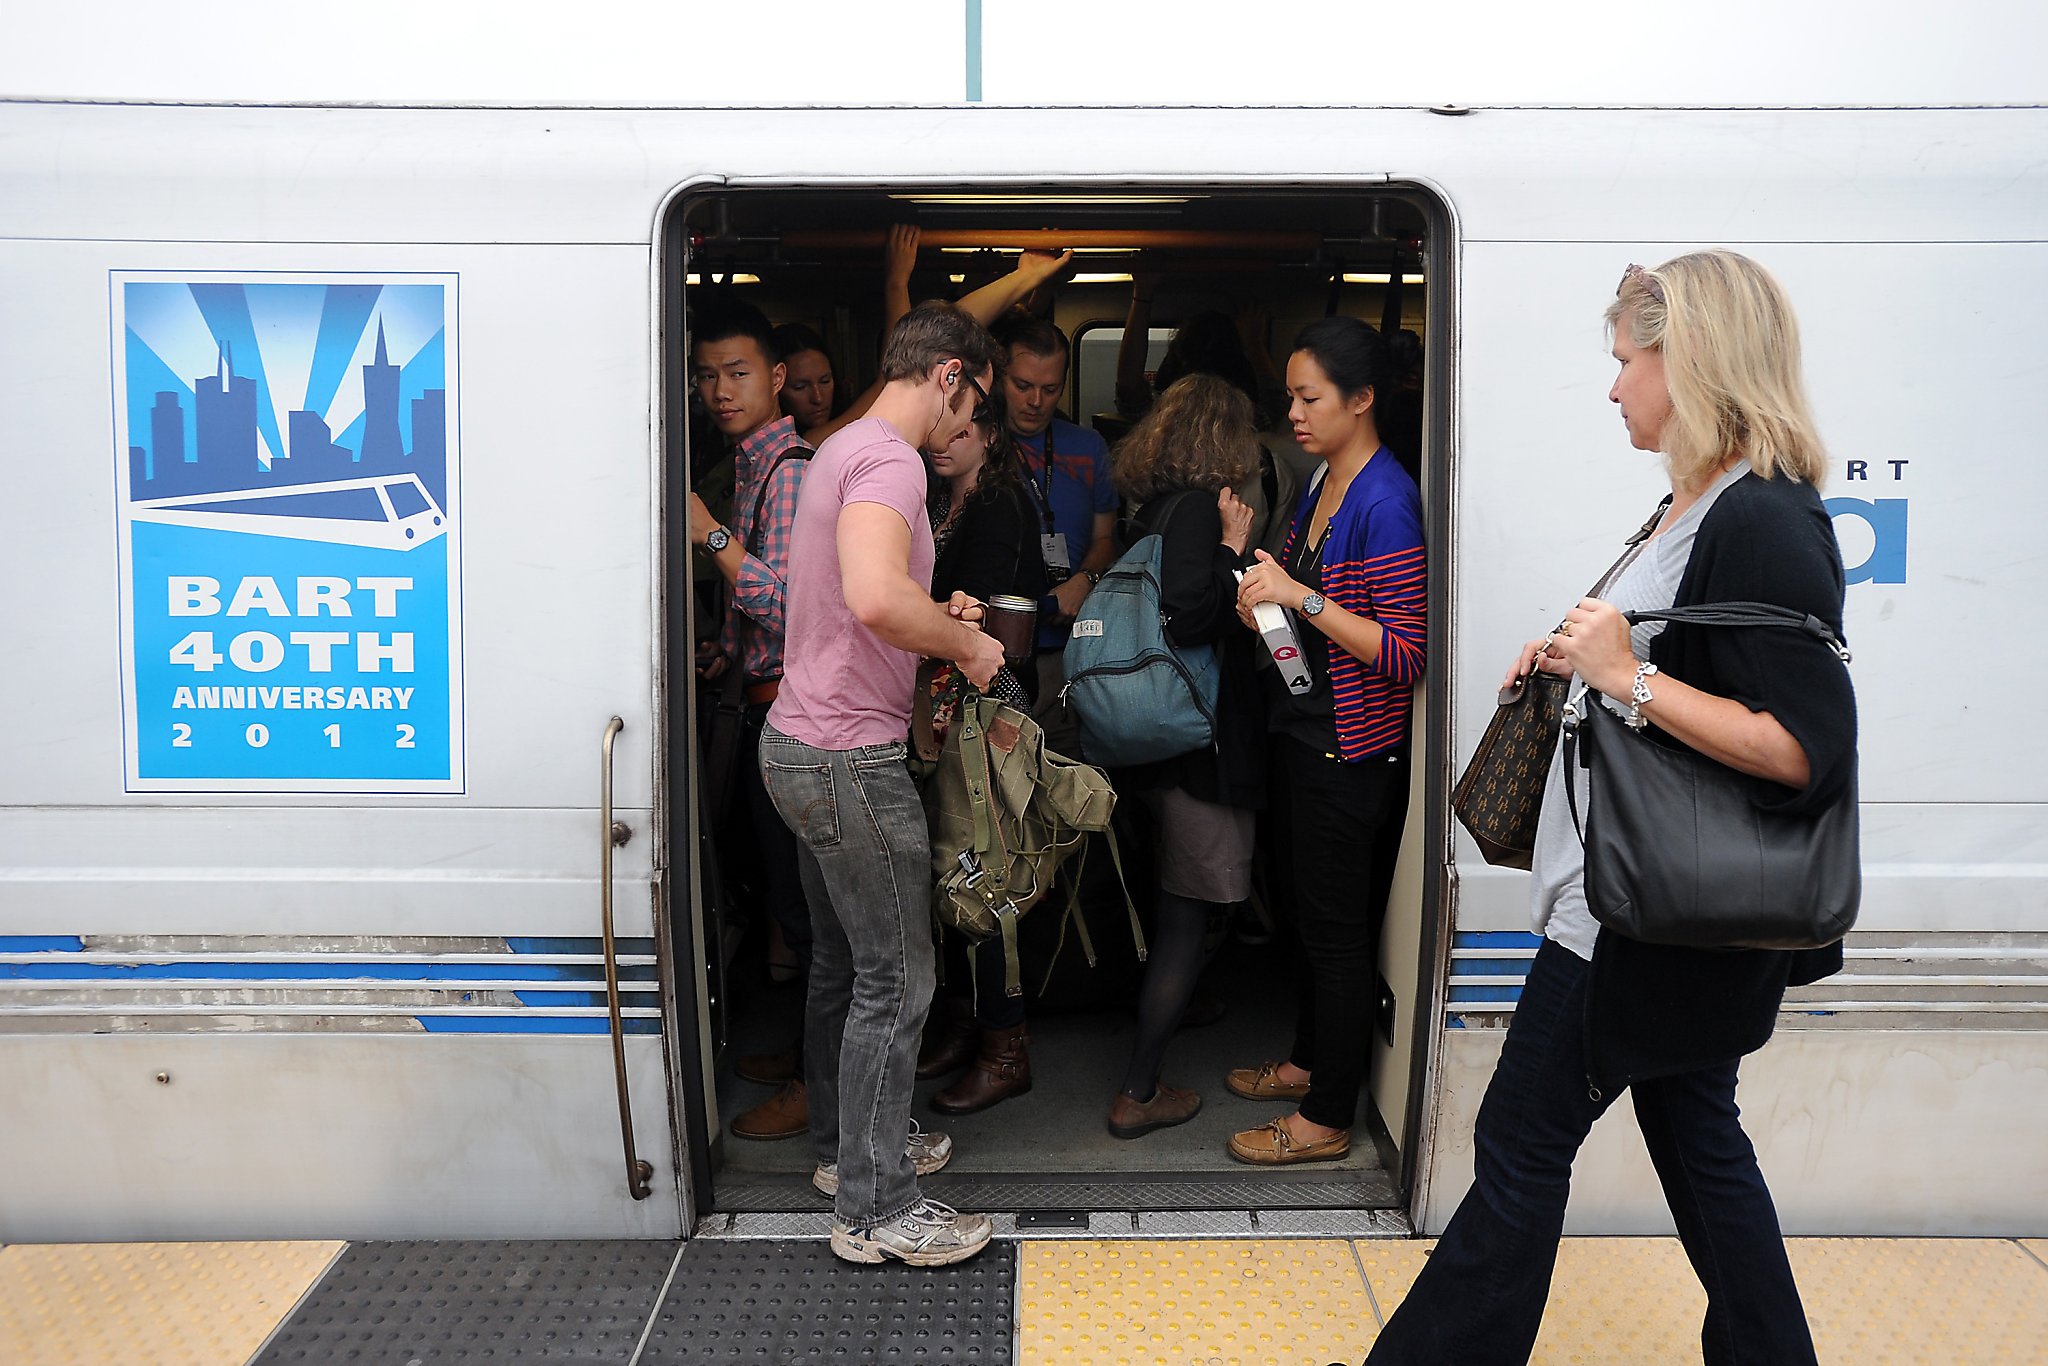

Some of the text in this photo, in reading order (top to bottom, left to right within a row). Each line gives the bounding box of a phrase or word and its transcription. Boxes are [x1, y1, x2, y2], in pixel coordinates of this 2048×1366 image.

[1847, 460, 1909, 481] RT
[167, 576, 414, 617] BART
[168, 630, 415, 673] 40TH
[171, 686, 415, 710] ANNIVERSARY
[901, 1219, 920, 1233] FILA
